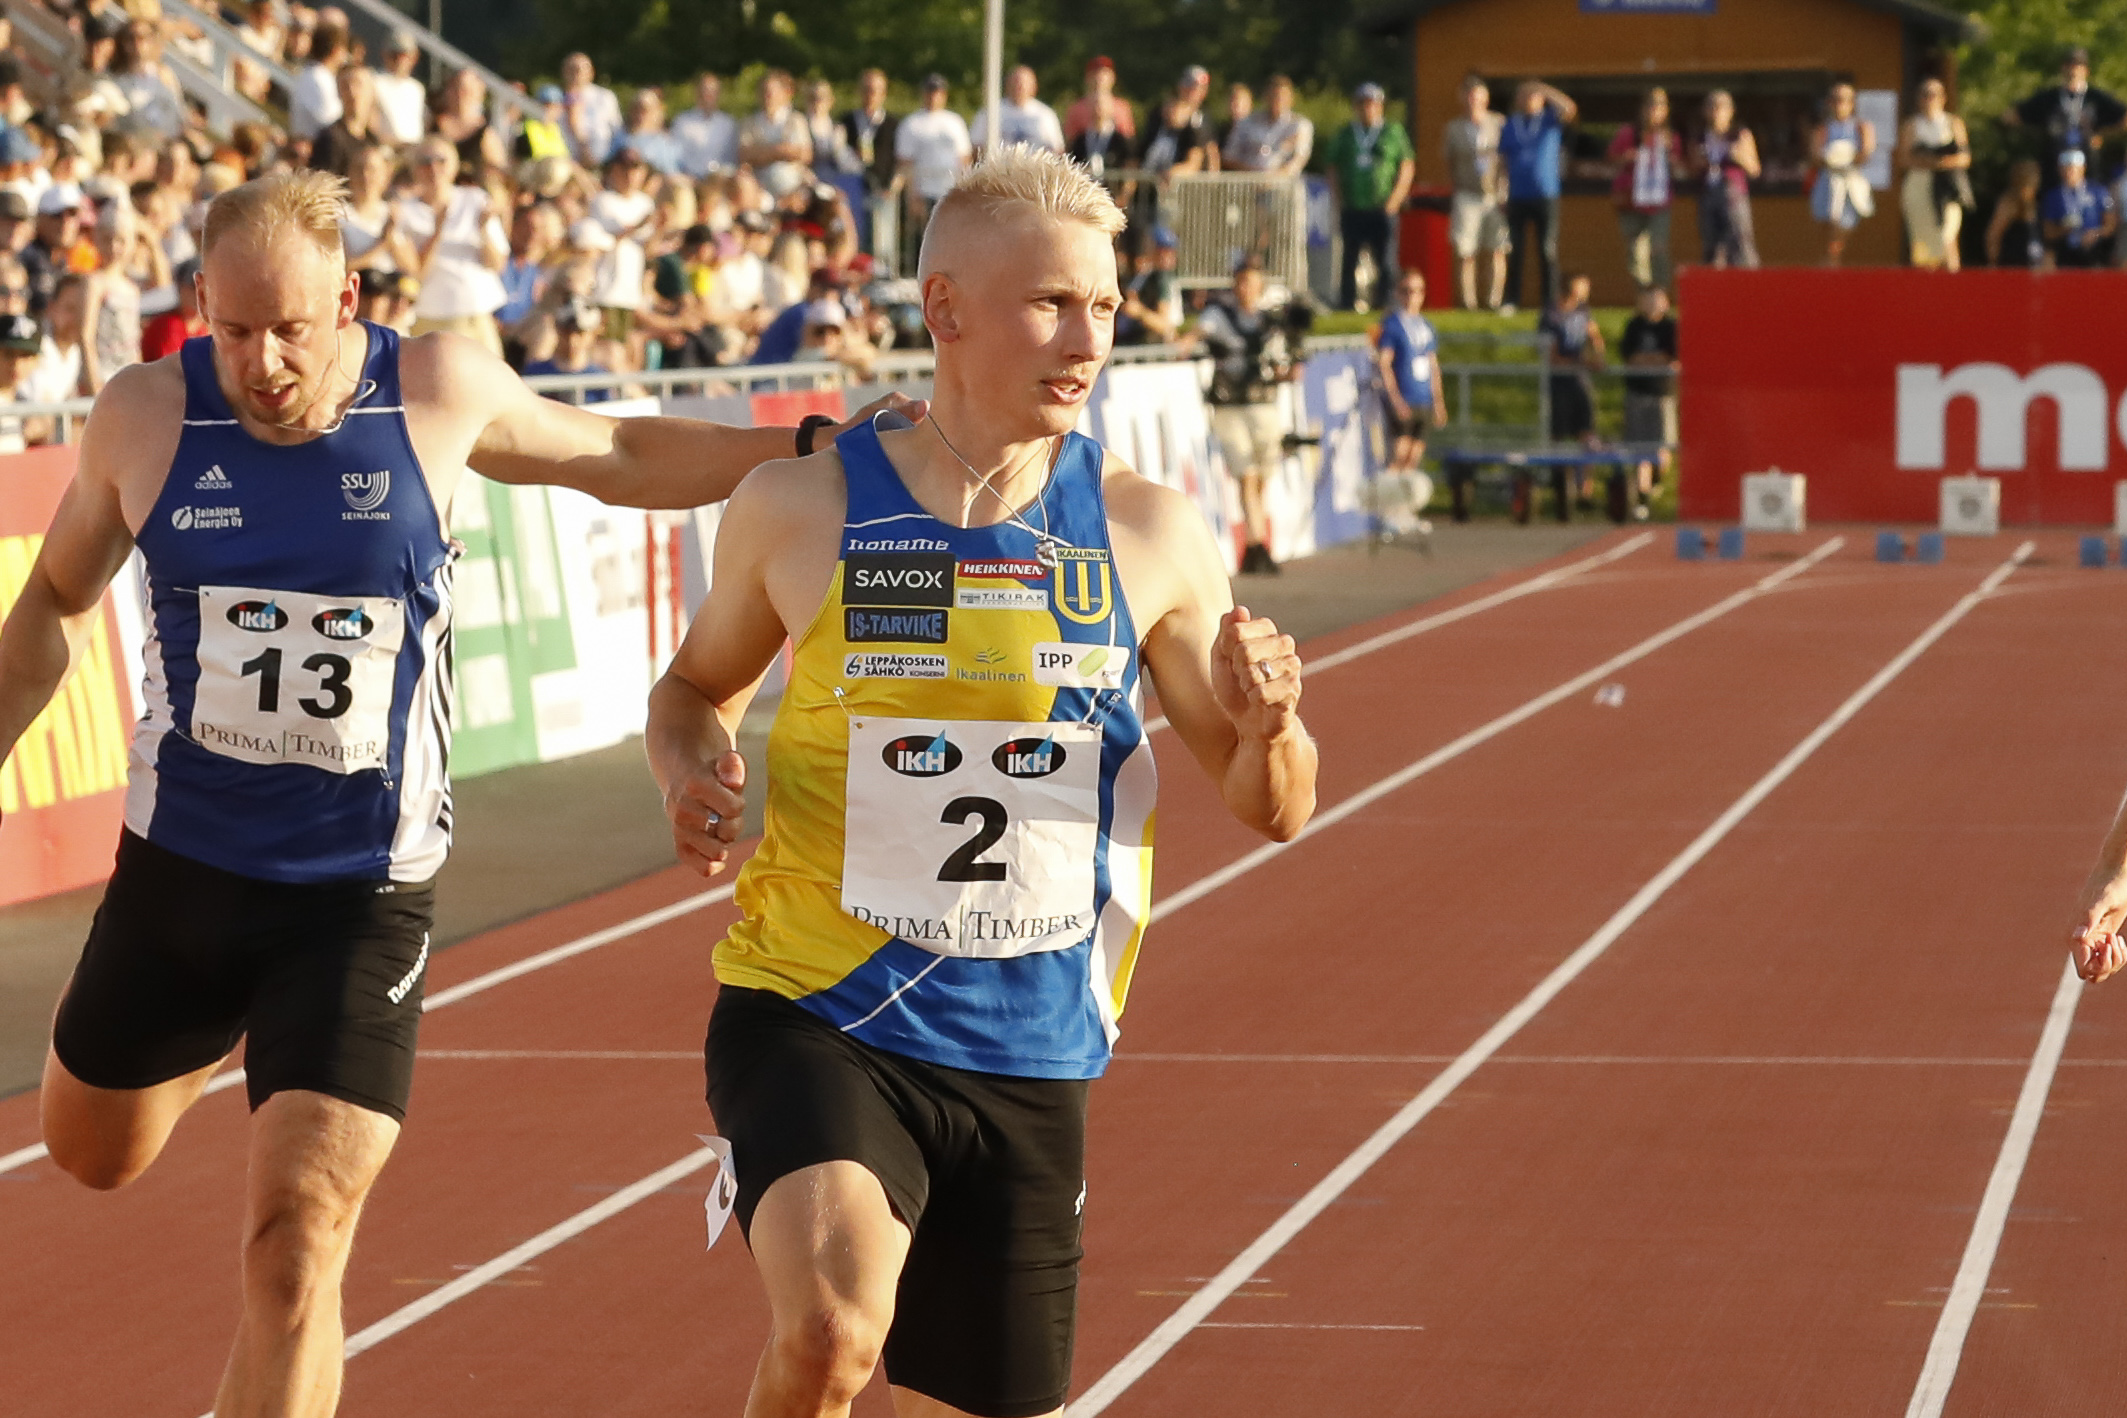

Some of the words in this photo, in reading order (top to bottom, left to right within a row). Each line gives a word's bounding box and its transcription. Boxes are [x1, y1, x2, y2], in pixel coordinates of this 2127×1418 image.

[1896, 362, 2127, 472] m
[195, 481, 232, 490] adidas
[341, 473, 372, 489] SSU
[194, 517, 229, 529] Energia
[847, 538, 949, 551] noname
[963, 563, 1044, 576] HEIKKINEN
[855, 569, 944, 589] SAVOX
[982, 593, 1045, 602] TIKIRAK
[849, 611, 943, 640] IS-TARVIKE
[1038, 652, 1073, 669] IPP
[241, 646, 353, 720] 13
[956, 667, 1026, 682] Ikaalinen
[199, 722, 278, 754] PRIMA
[290, 733, 377, 762] TIMBER
[936, 795, 1008, 882] 2
[851, 905, 954, 940] PRIMA
[969, 911, 1083, 940] TIMBER
